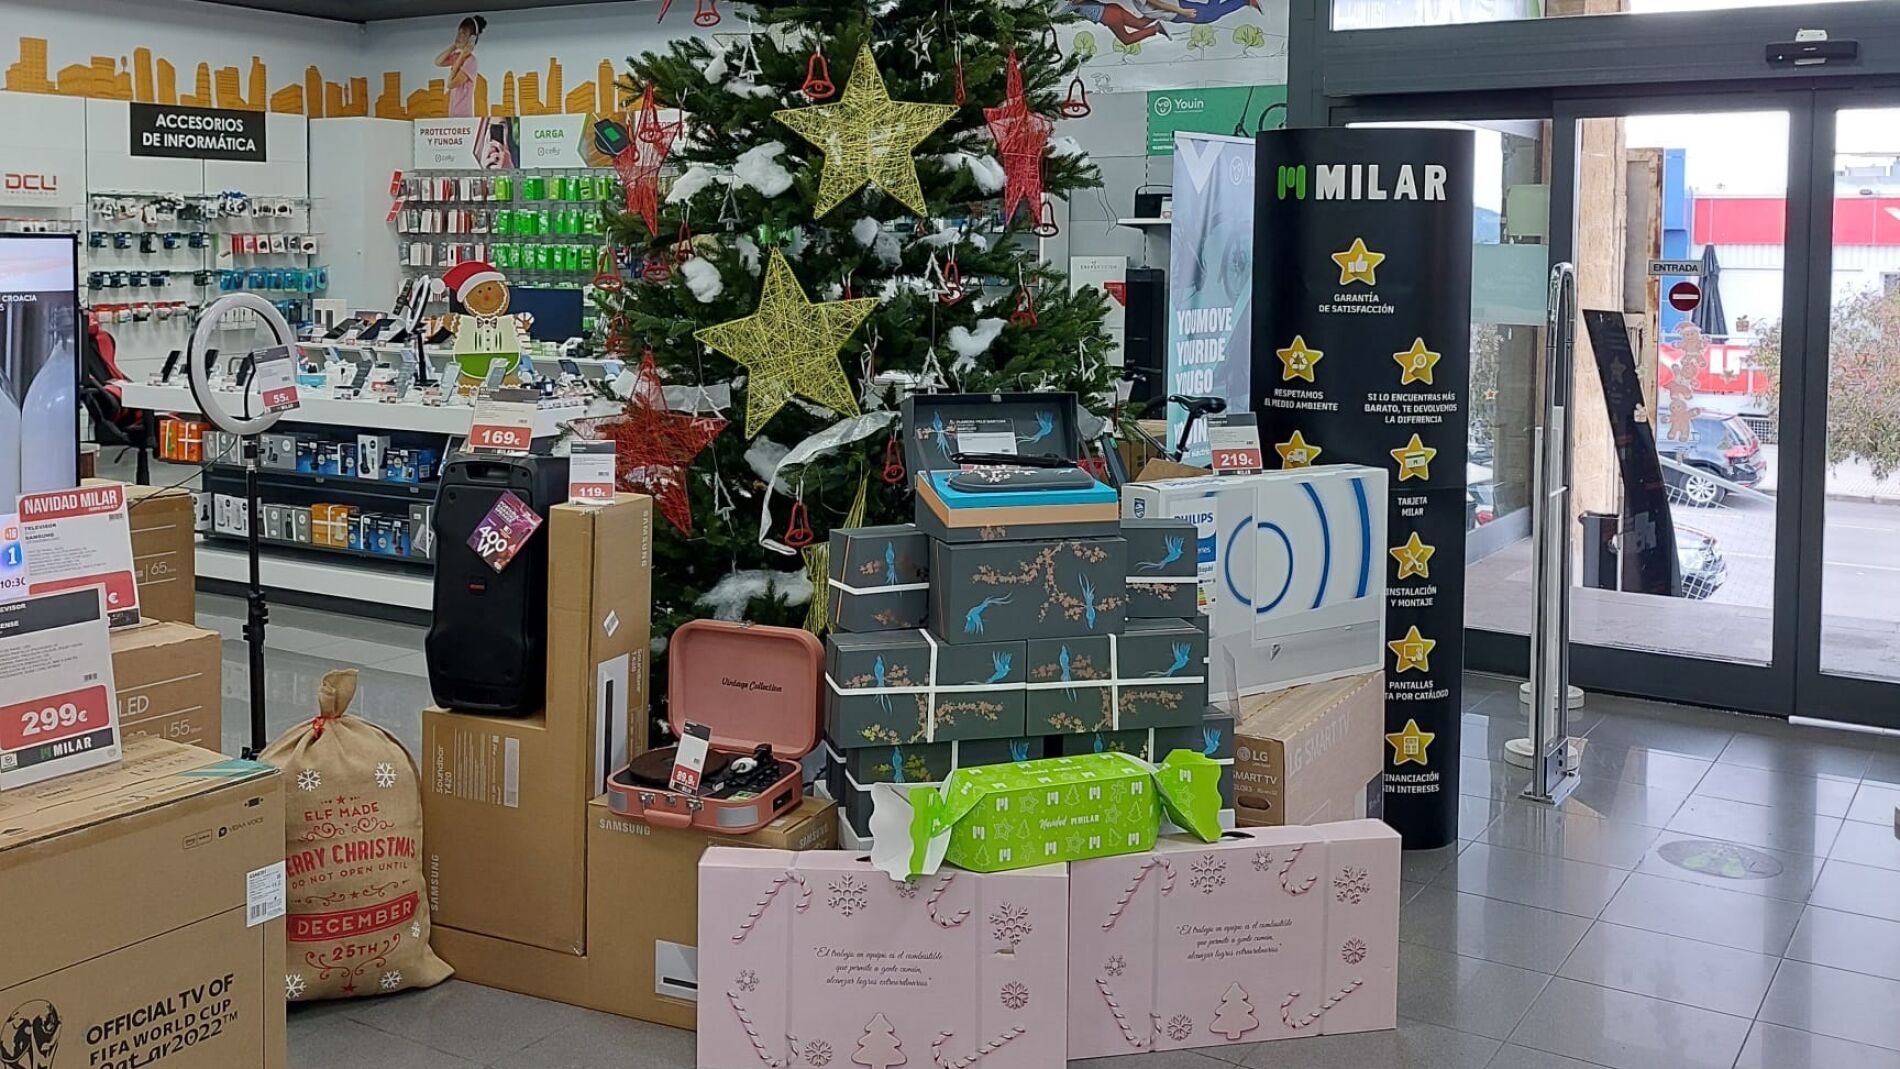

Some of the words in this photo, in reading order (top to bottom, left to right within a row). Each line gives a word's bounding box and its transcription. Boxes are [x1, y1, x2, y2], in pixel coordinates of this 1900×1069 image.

[1174, 98, 1204, 111] Youin
[155, 113, 244, 132] ACCESORIOS
[420, 127, 471, 136] PROTECTORES
[534, 129, 564, 139] CARGA
[142, 132, 161, 146] DE
[164, 133, 256, 152] INFORMÁTICA
[5, 173, 57, 191] DCU
[1315, 164, 1447, 201] MILAR
[1653, 263, 1698, 272] ENTRADA
[2, 294, 38, 303] CROACIA
[1333, 291, 1379, 302] GARANTÍA
[1318, 304, 1330, 313] DE
[1331, 303, 1394, 314] SATISFACCIÓN
[1177, 307, 1233, 335] YOUMOVE
[1176, 338, 1226, 366] YOURIDE
[1175, 368, 1214, 396] YOUGO
[1274, 388, 1324, 400] RESPETAMOS
[1367, 393, 1377, 401] SI
[1379, 393, 1389, 401] LO
[1391, 393, 1441, 402] ENCUENTRAS
[1441, 390, 1456, 401] MÁS
[1271, 398, 1295, 409] MEDIO
[1295, 401, 1339, 411] AMBIENTE
[1364, 404, 1400, 414] BARATO,
[1402, 405, 1412, 413] TE
[1413, 404, 1457, 413] DEVOLVEMOS
[1385, 415, 1396, 424] LA
[1397, 415, 1442, 424] DIFERENCIA
[24, 494, 78, 515] NAVIDAD
[80, 489, 117, 508] MILAR
[1397, 496, 1428, 505] TARJETA
[1401, 507, 1424, 517] MILAR
[479, 526, 508, 552] 400
[641, 510, 649, 567] SAMSUNG
[476, 538, 495, 558] W
[8, 546, 17, 565] 1
[151, 561, 167, 575] 65
[1385, 585, 1437, 596] INSTALACIÓN
[1390, 599, 1397, 607] Y
[1398, 597, 1434, 607] MONTAJE
[721, 677, 748, 689] Vintage
[749, 681, 782, 692] Collection
[1389, 680, 1434, 689] PANTALLAS
[1396, 692, 1413, 700] POR
[1414, 688, 1448, 700] CATÁLOGO
[169, 719, 190, 738] 55
[53, 736, 92, 757] MILAR
[1287, 748, 1302, 777] LG
[1305, 722, 1336, 765] SMART
[1337, 711, 1350, 737] TV
[1252, 750, 1269, 762] LG
[435, 745, 444, 794] Soundbar
[1263, 774, 1278, 785] TV
[1383, 771, 1439, 783] INANCIACIÓN
[1383, 785, 1395, 793] IN
[1396, 784, 1440, 793] INTERESES
[304, 808, 332, 822] ELF
[339, 802, 380, 818] MADE
[599, 818, 650, 836] SAMSUNG
[286, 847, 325, 878] ERRY
[331, 836, 416, 864] CHRISTMAS
[292, 879, 305, 889] DO
[310, 872, 334, 884] NOT
[340, 866, 373, 878] OPEN
[379, 861, 408, 871] UNTIL
[431, 854, 439, 912] SAMSUNG
[298, 900, 412, 935] DECEMBER
[1252, 920, 1259, 929] el
[332, 943, 377, 961] 25TH
[831, 949, 854, 960] trabajo
[866, 952, 886, 961] equipo
[897, 950, 905, 959] el
[905, 951, 942, 960] combustible
[835, 965, 848, 973] que
[848, 963, 872, 974] permite
[881, 965, 898, 974] gente
[856, 976, 877, 988] logros
[86, 997, 176, 1045] OFFICIAL
[179, 984, 205, 1009] TV
[208, 973, 234, 997] OF
[89, 1040, 130, 1066] FIFA
[133, 1013, 196, 1048] WORLD
[200, 998, 232, 1021] CUP
